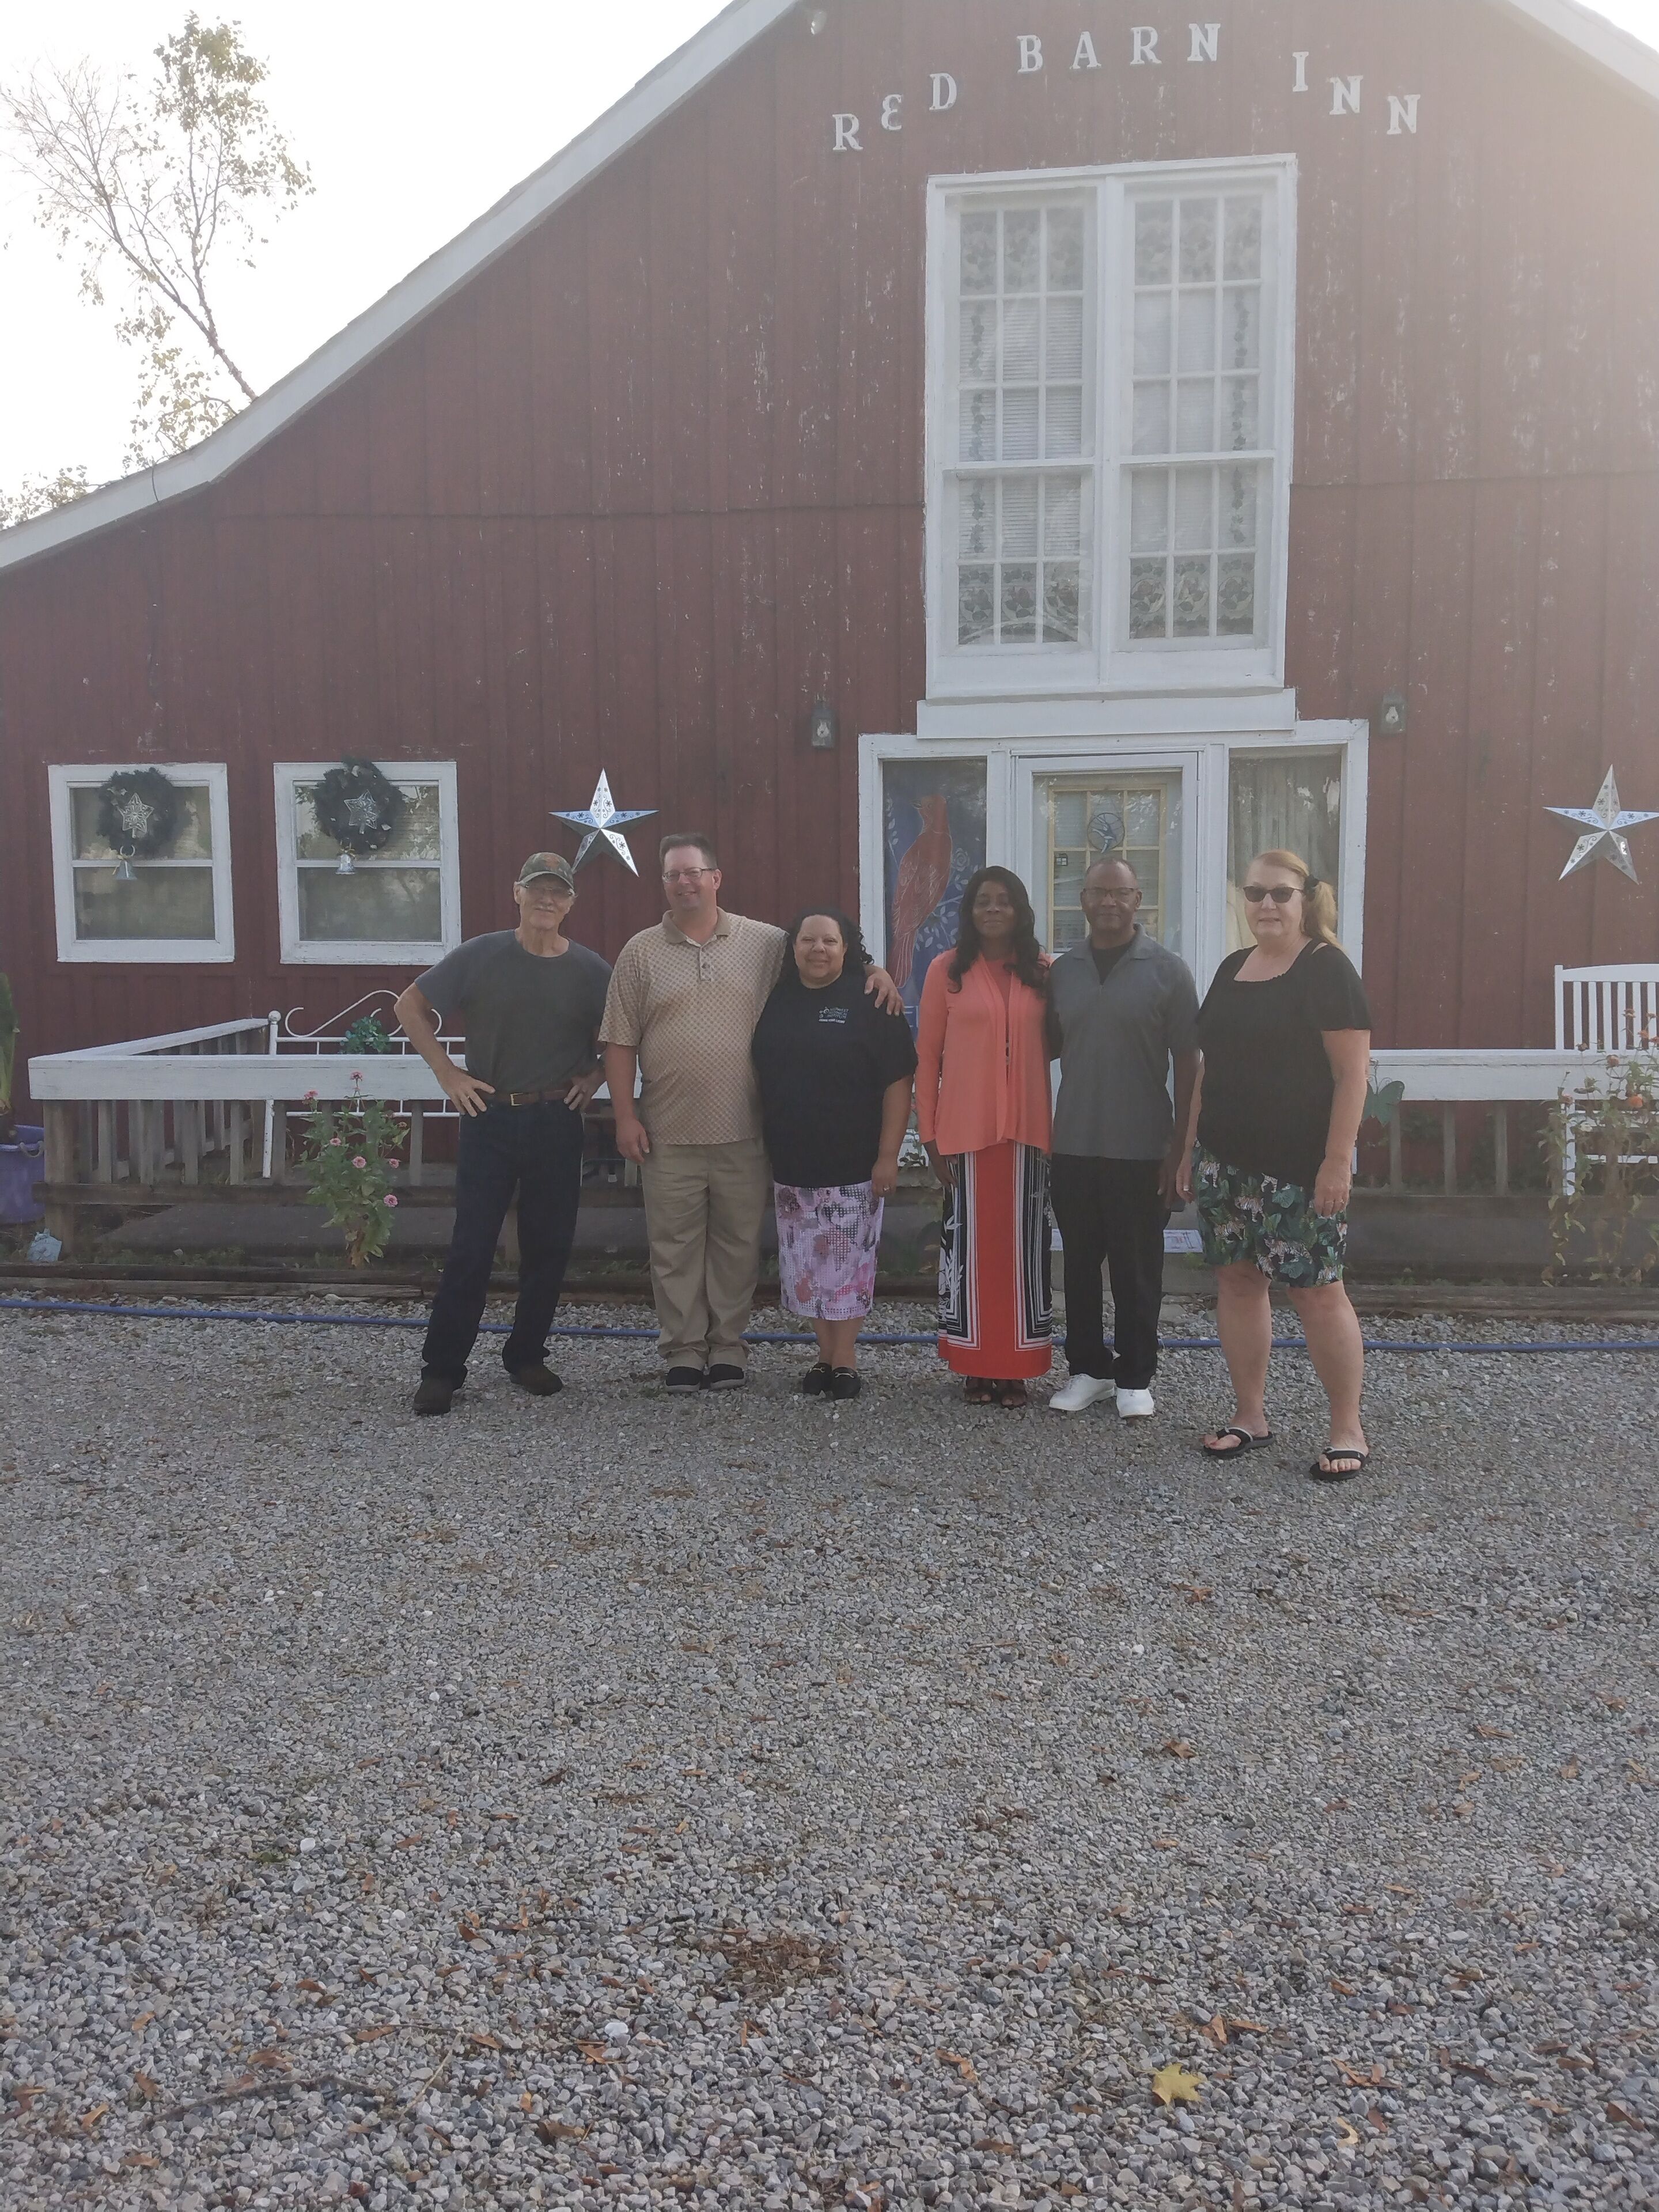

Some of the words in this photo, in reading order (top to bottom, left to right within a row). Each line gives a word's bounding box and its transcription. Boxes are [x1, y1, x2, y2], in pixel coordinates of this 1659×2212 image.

[832, 73, 957, 150] RED
[1017, 23, 1221, 74] BARN
[1292, 51, 1421, 135] INN
